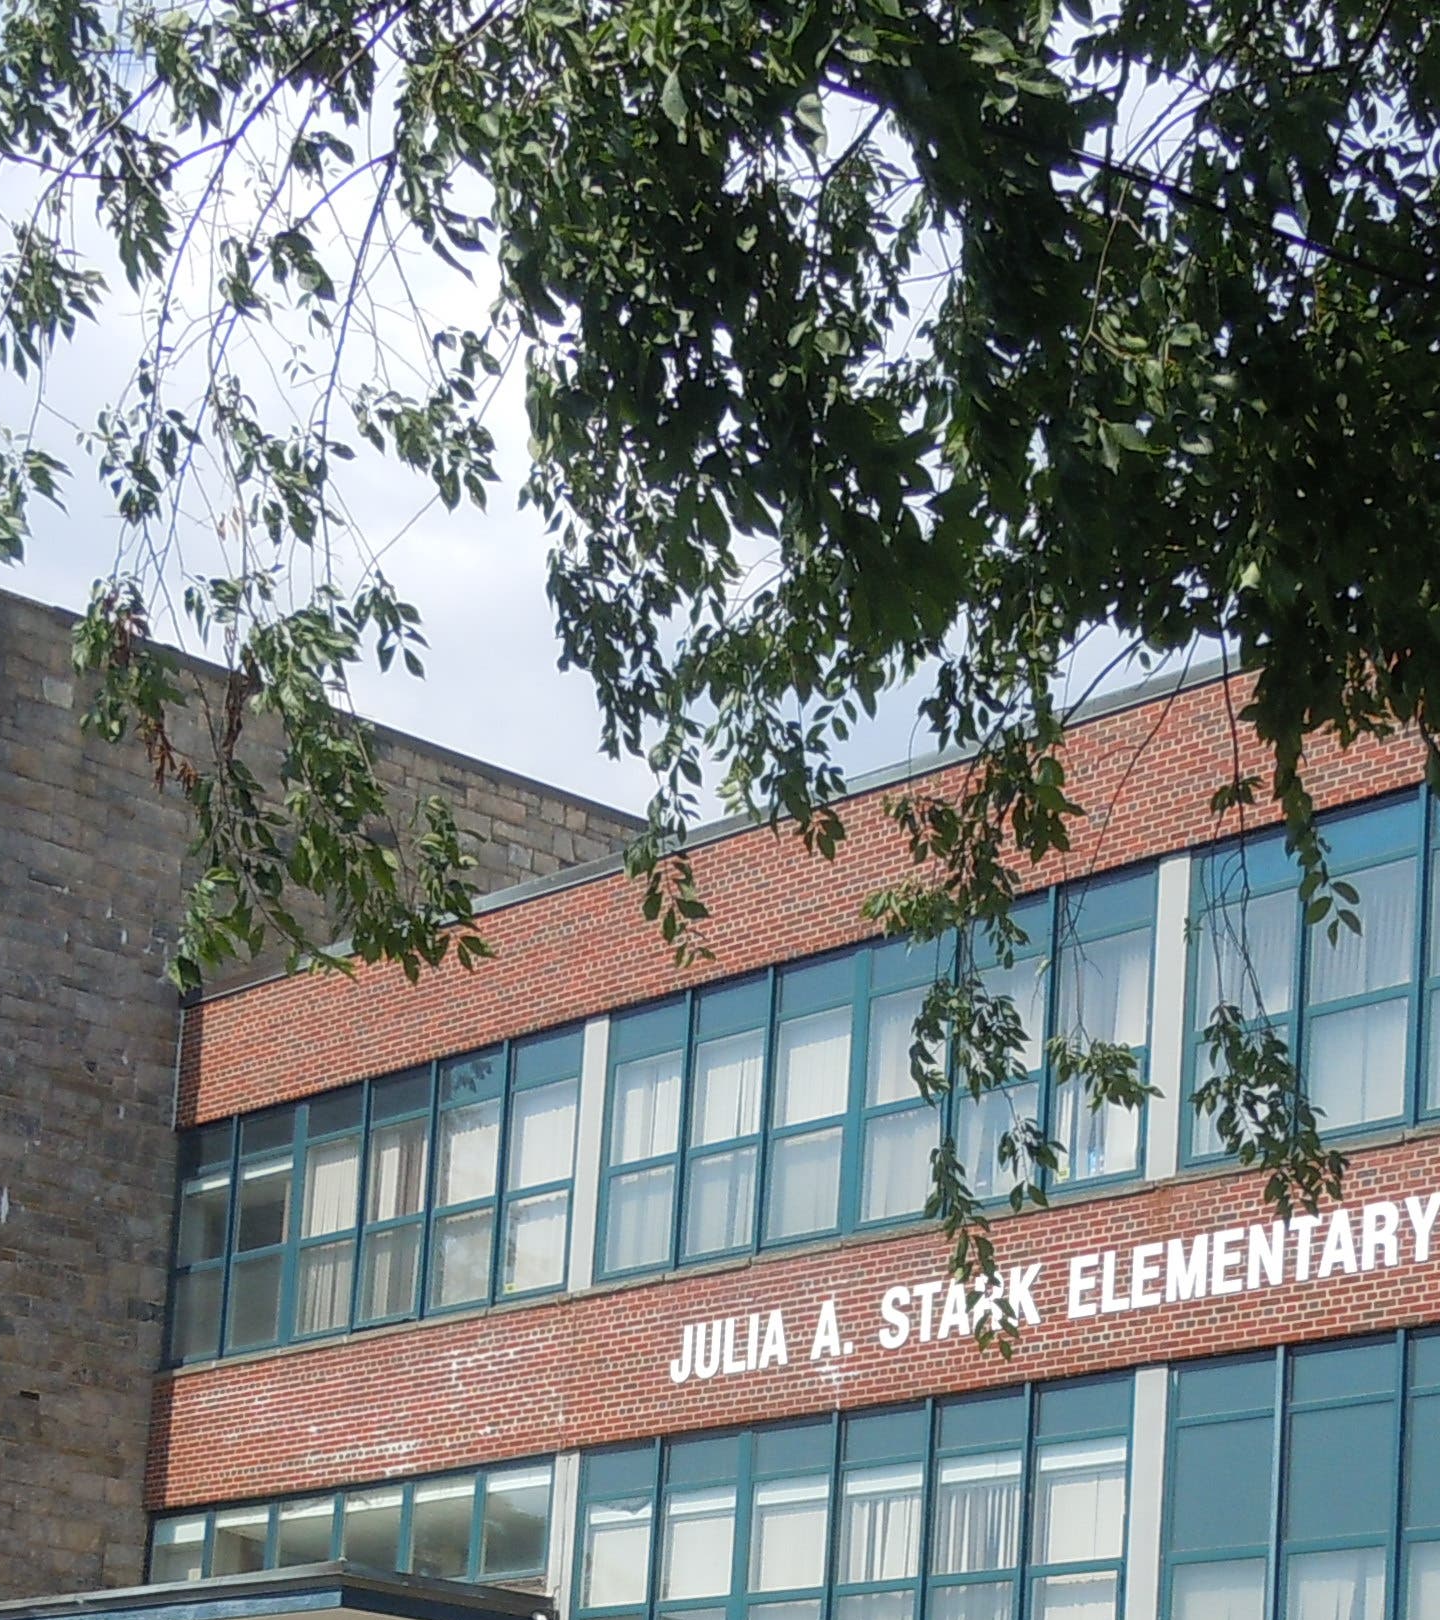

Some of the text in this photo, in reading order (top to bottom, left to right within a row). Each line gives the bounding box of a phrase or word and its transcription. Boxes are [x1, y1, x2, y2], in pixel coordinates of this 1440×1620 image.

[669, 1308, 789, 1384] JULIA
[810, 1300, 854, 1361] A.
[878, 1262, 1043, 1350] STARK
